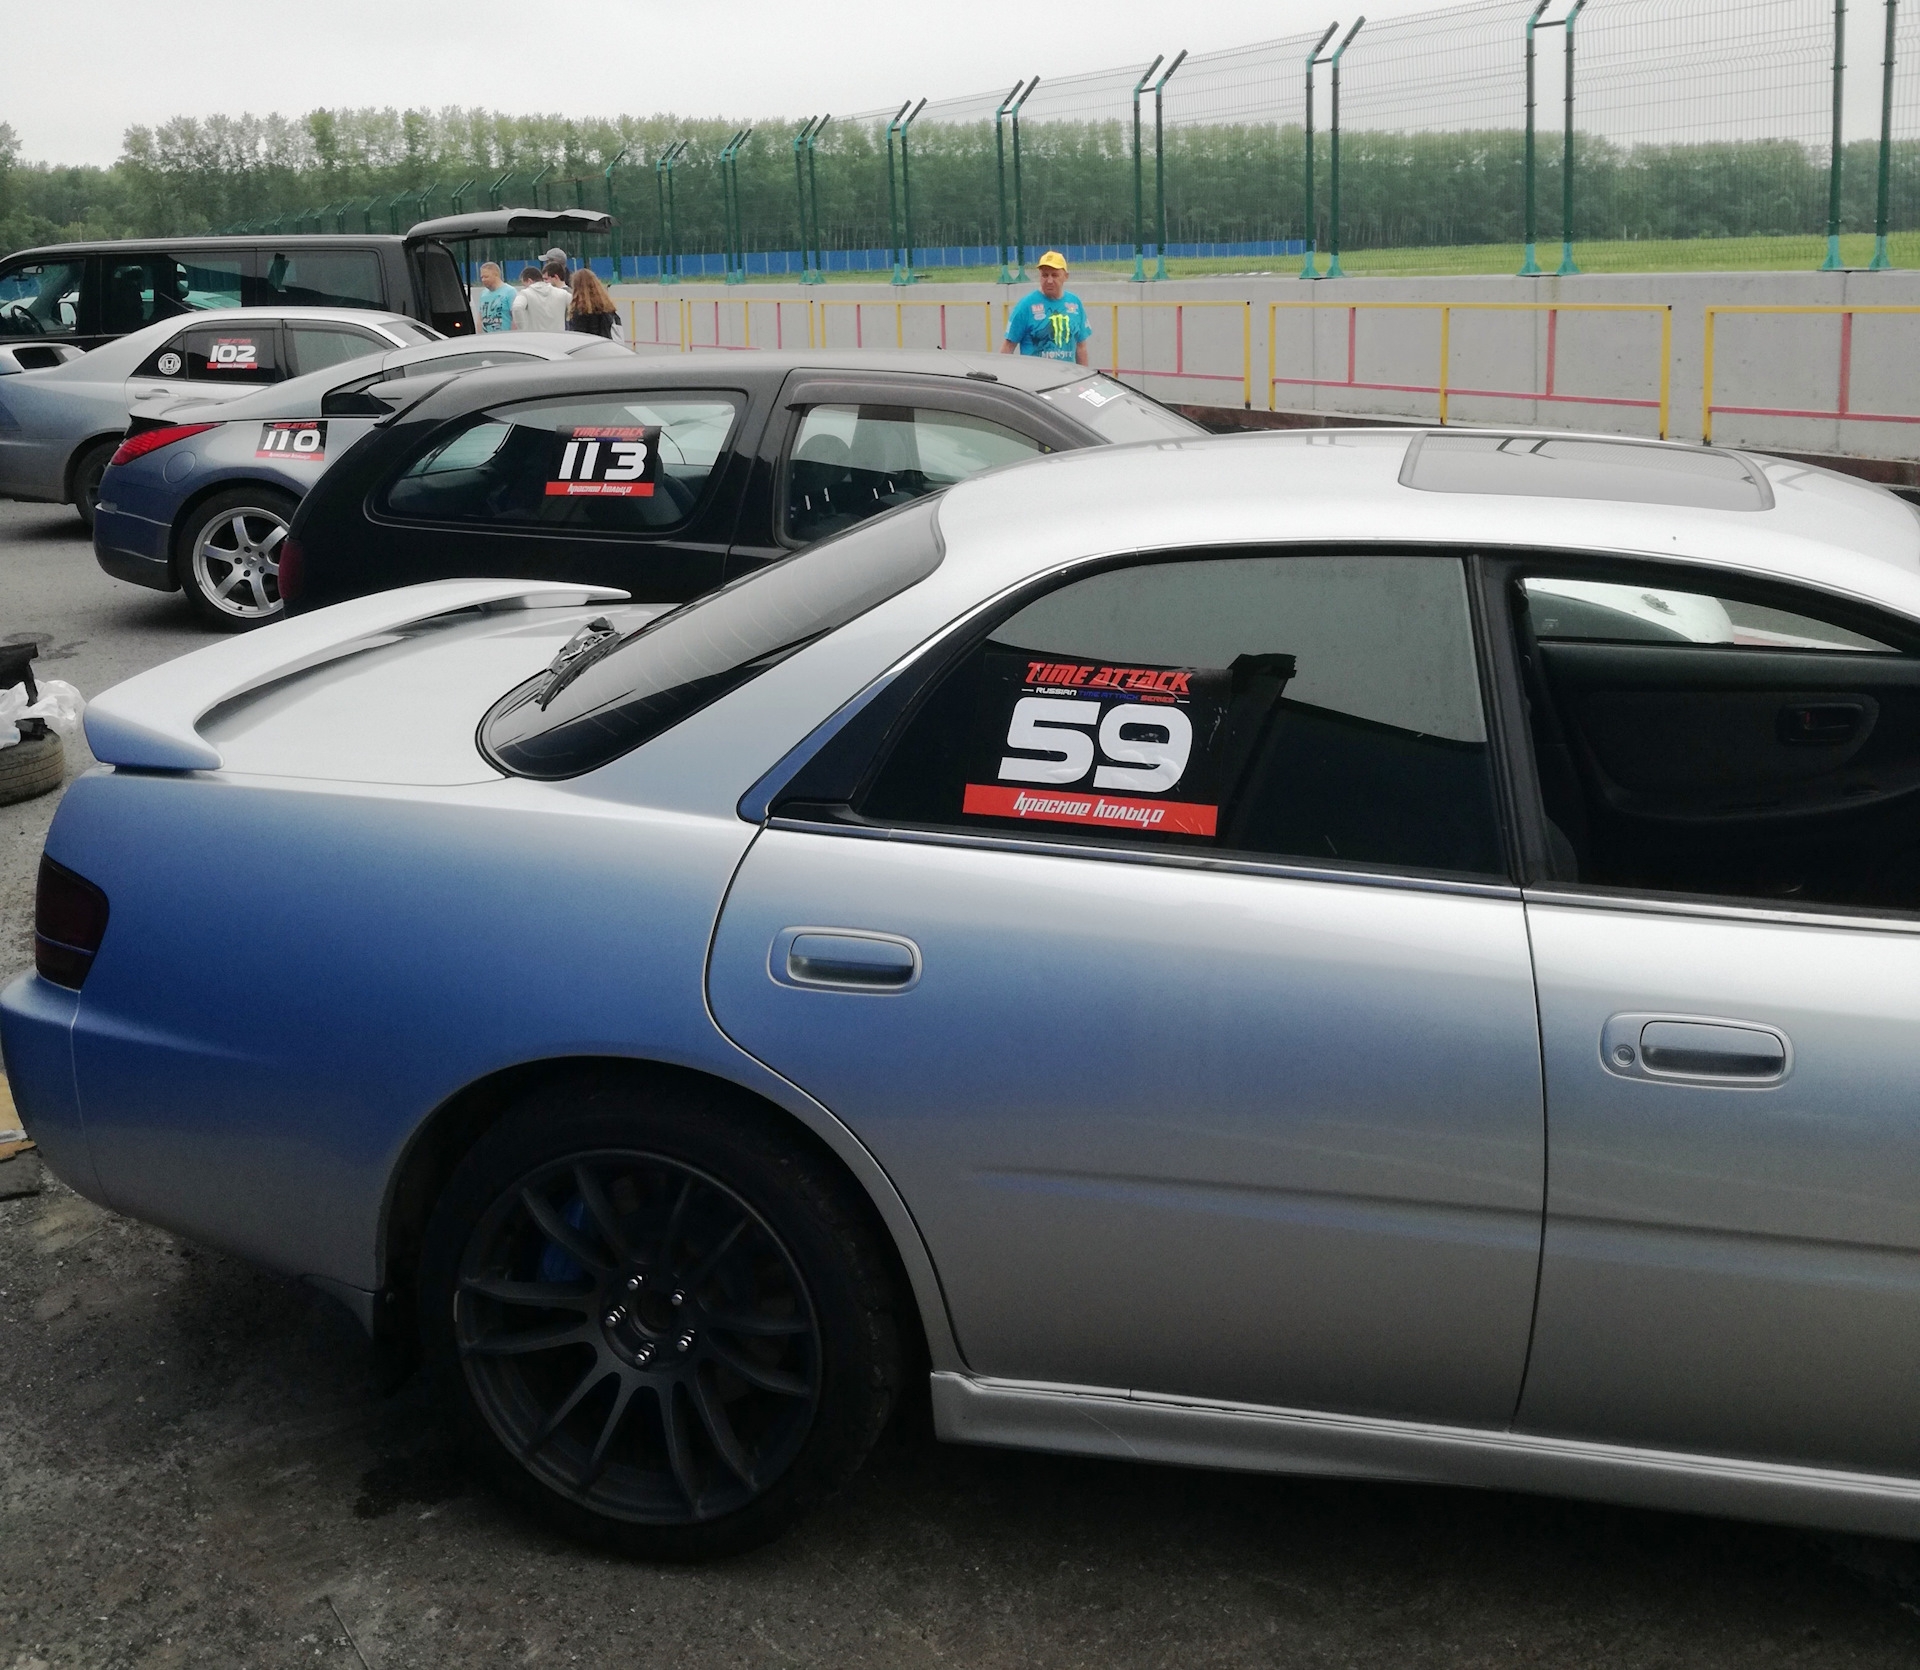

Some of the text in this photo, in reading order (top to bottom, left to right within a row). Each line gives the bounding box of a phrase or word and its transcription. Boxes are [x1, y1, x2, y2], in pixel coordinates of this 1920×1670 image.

[210, 345, 256, 363] 102
[263, 429, 321, 452] 110
[600, 427, 645, 438] ATTACK
[558, 442, 648, 480] 113
[1025, 661, 1193, 693] TIME ATTACK
[1035, 687, 1077, 696] RUSSIAN
[1078, 690, 1101, 698] TIME
[1100, 691, 1140, 701] ATTACK
[997, 696, 1193, 793] 59
